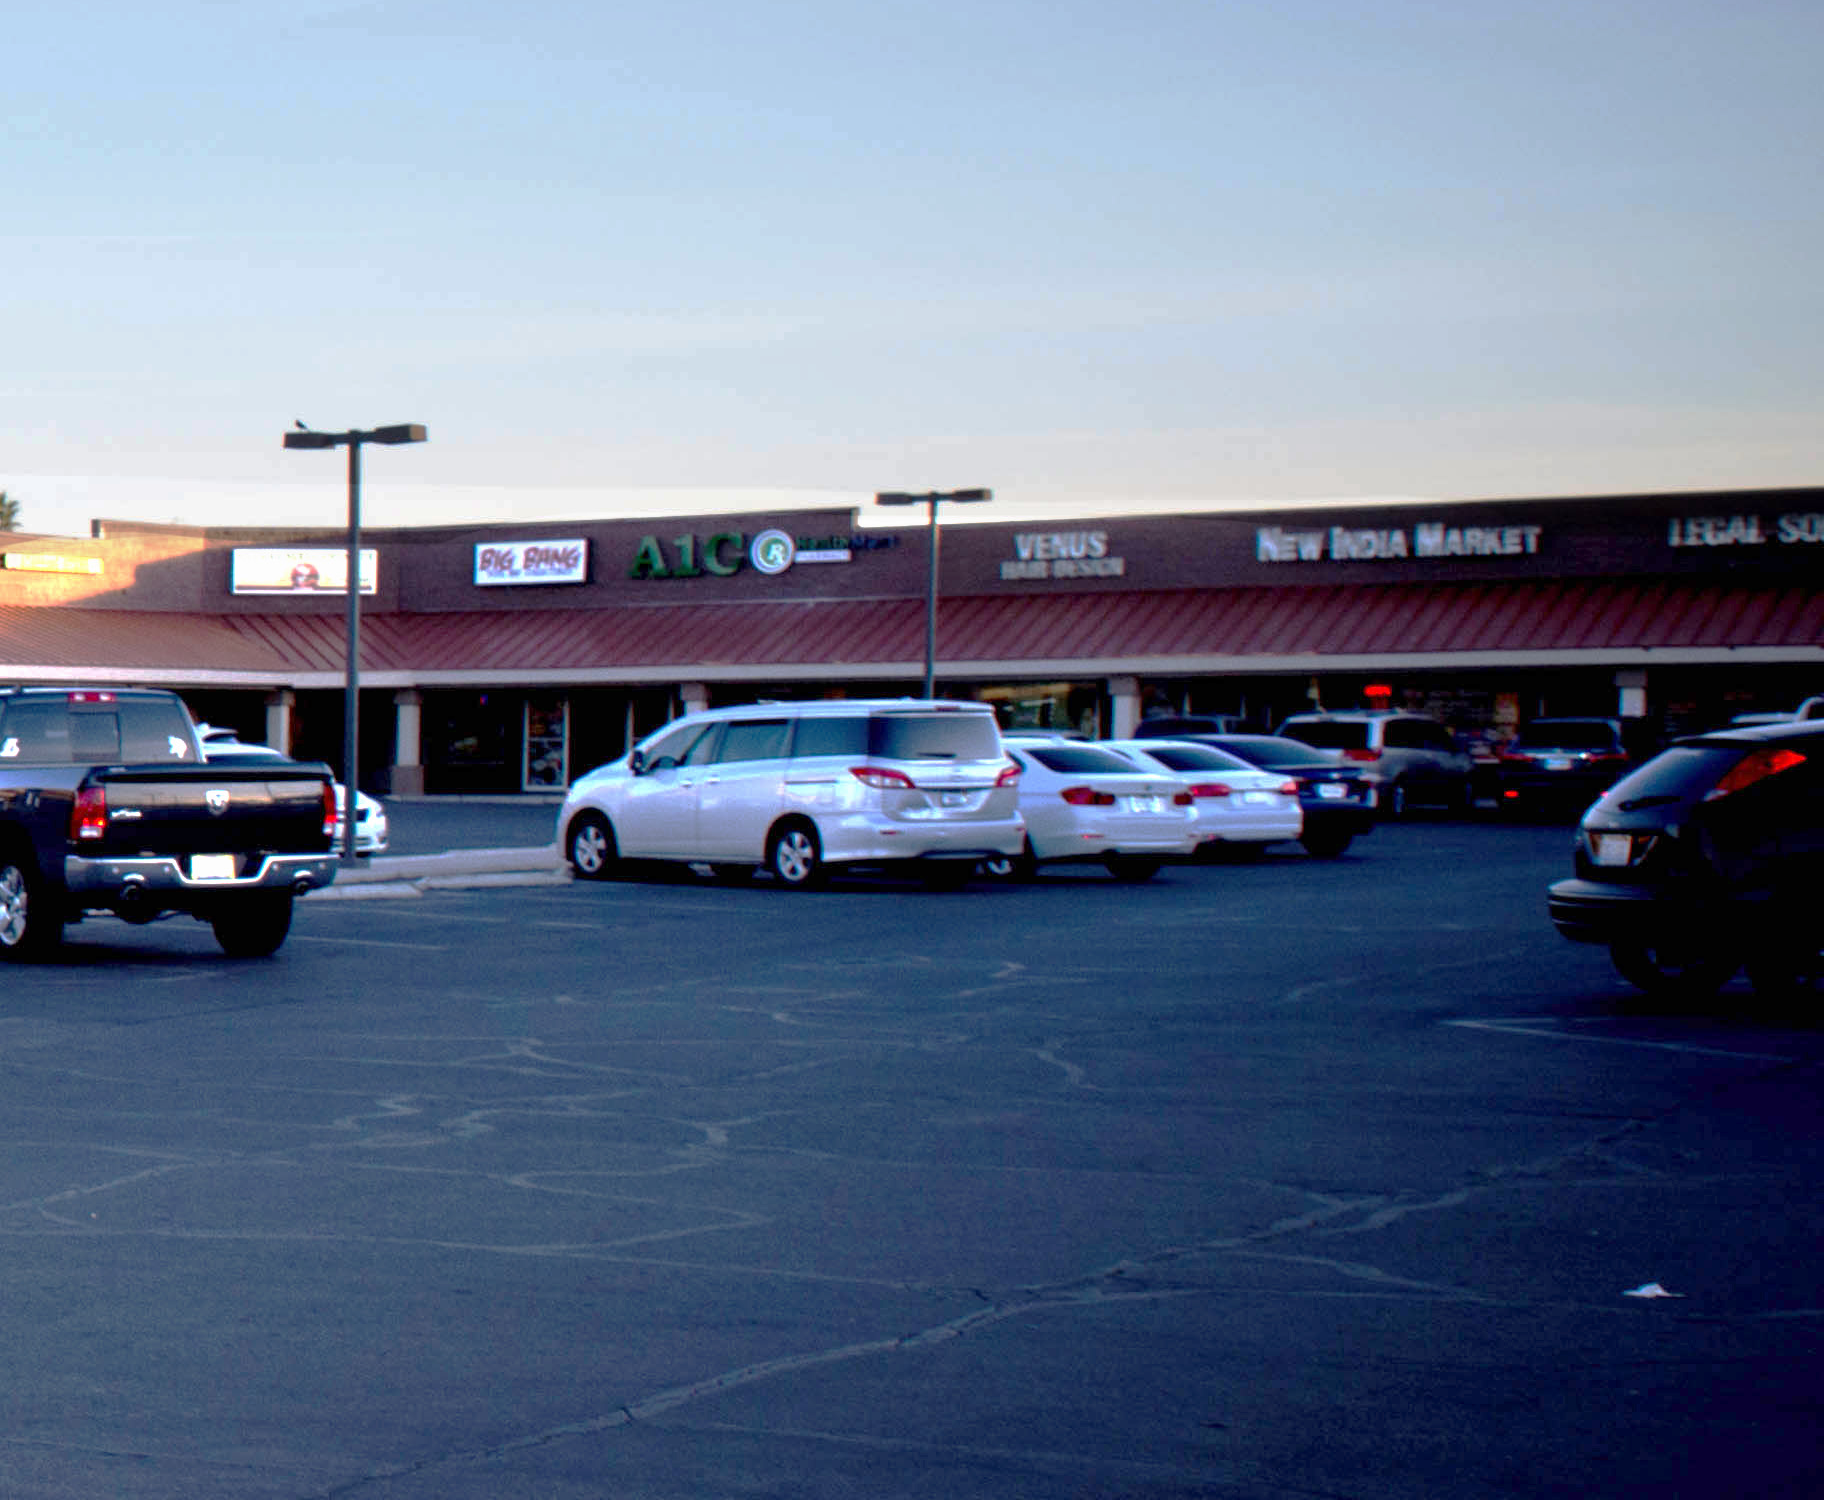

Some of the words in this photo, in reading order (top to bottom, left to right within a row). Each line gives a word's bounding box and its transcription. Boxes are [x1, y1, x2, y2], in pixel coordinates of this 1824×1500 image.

[1015, 531, 1108, 560] VENUS
[1668, 516, 1767, 547] LEGAL
[479, 548, 513, 572] BIG
[523, 546, 579, 570] BANG
